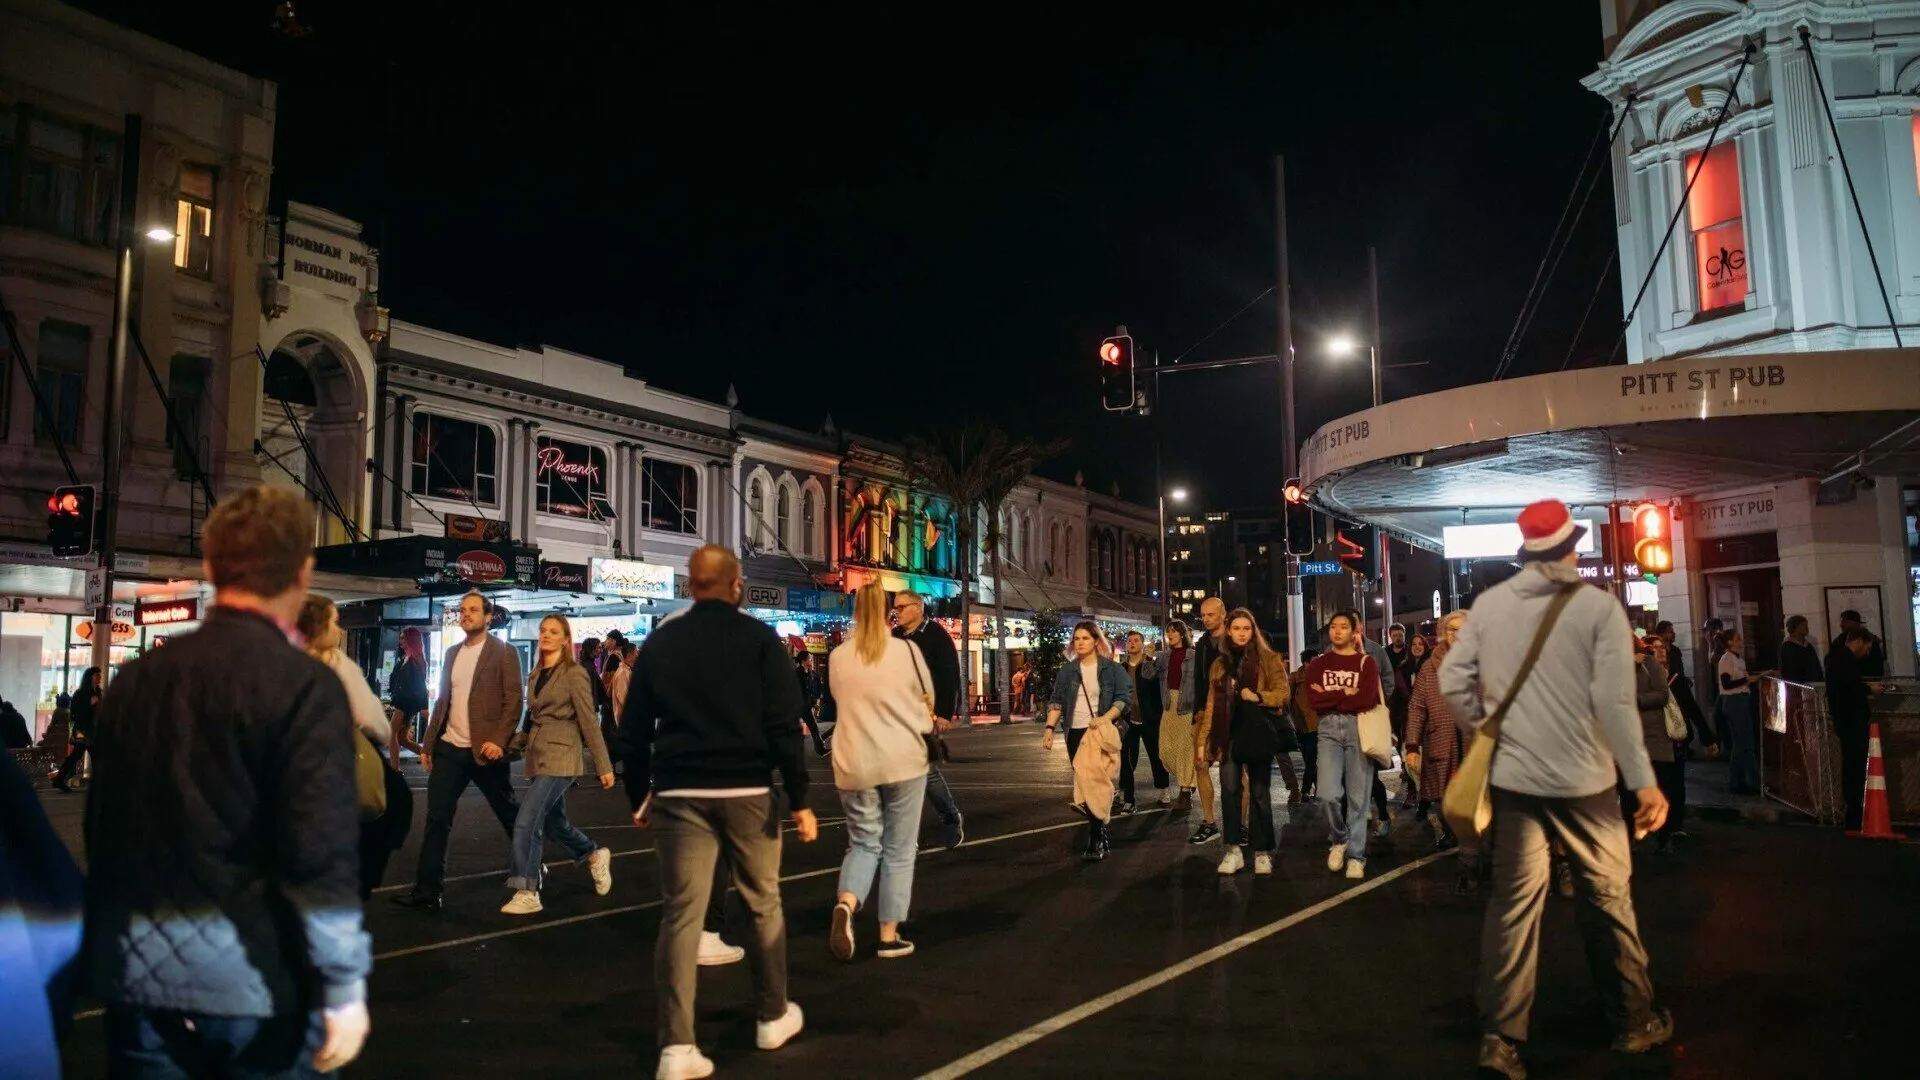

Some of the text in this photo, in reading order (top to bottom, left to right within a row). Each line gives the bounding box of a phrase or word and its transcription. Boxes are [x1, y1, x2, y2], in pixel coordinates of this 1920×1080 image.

[294, 259, 358, 287] BUILDING
[1621, 365, 1785, 396] PITT ST PUB
[1330, 427, 1343, 448] ST
[1345, 420, 1370, 443] PUB
[537, 447, 599, 484] Phoenix
[1700, 499, 1774, 521] PITT ST PUB
[545, 566, 584, 586] Phoenix
[1305, 563, 1336, 573] Pitt St
[1324, 671, 1356, 688] Bud
